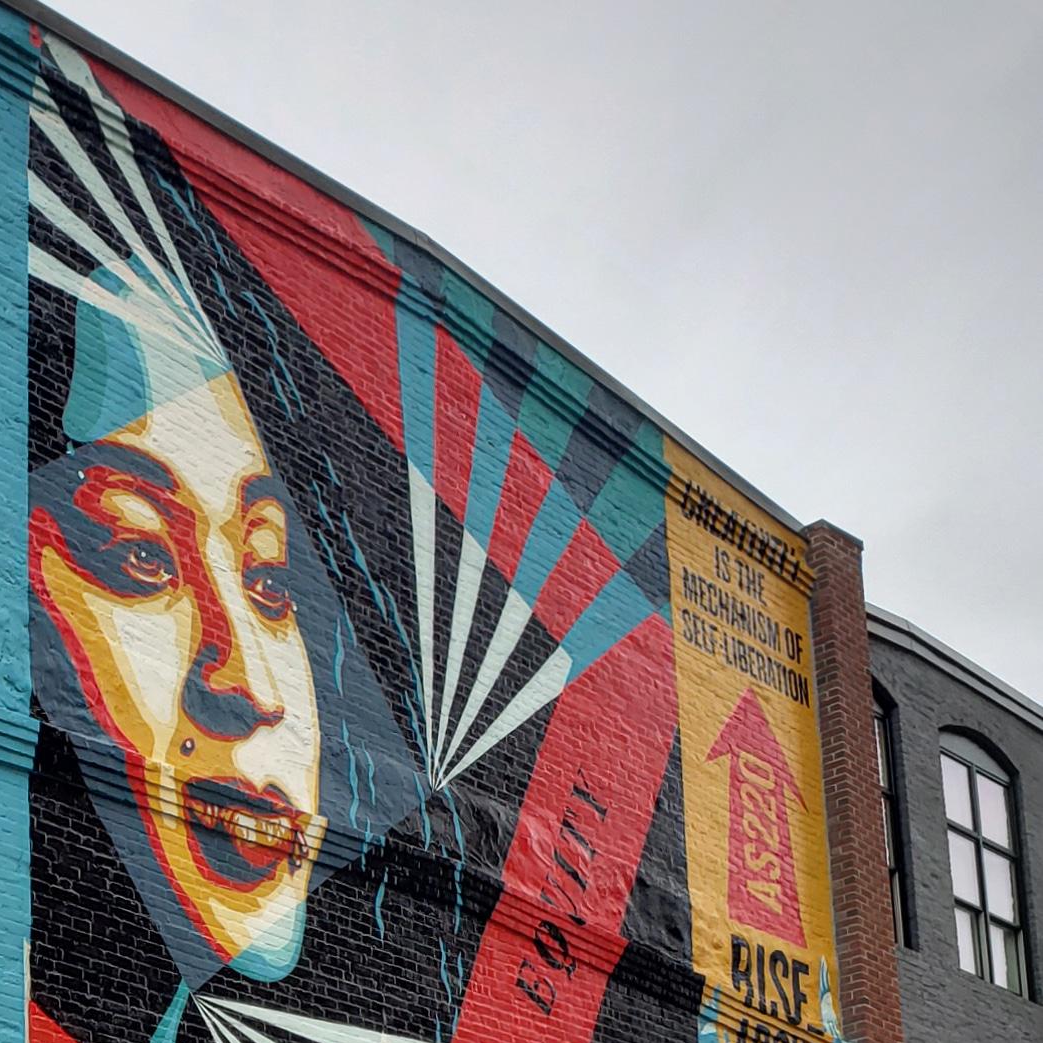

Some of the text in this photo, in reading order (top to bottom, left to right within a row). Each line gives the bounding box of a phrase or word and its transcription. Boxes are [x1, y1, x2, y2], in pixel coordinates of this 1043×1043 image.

[682, 566, 803, 664] MECHANISM OF
[715, 545, 767, 607] IS THE
[681, 608, 810, 708] SELF-LIBERATION
[739, 751, 783, 916] AS220
[731, 933, 824, 1036] RISE
